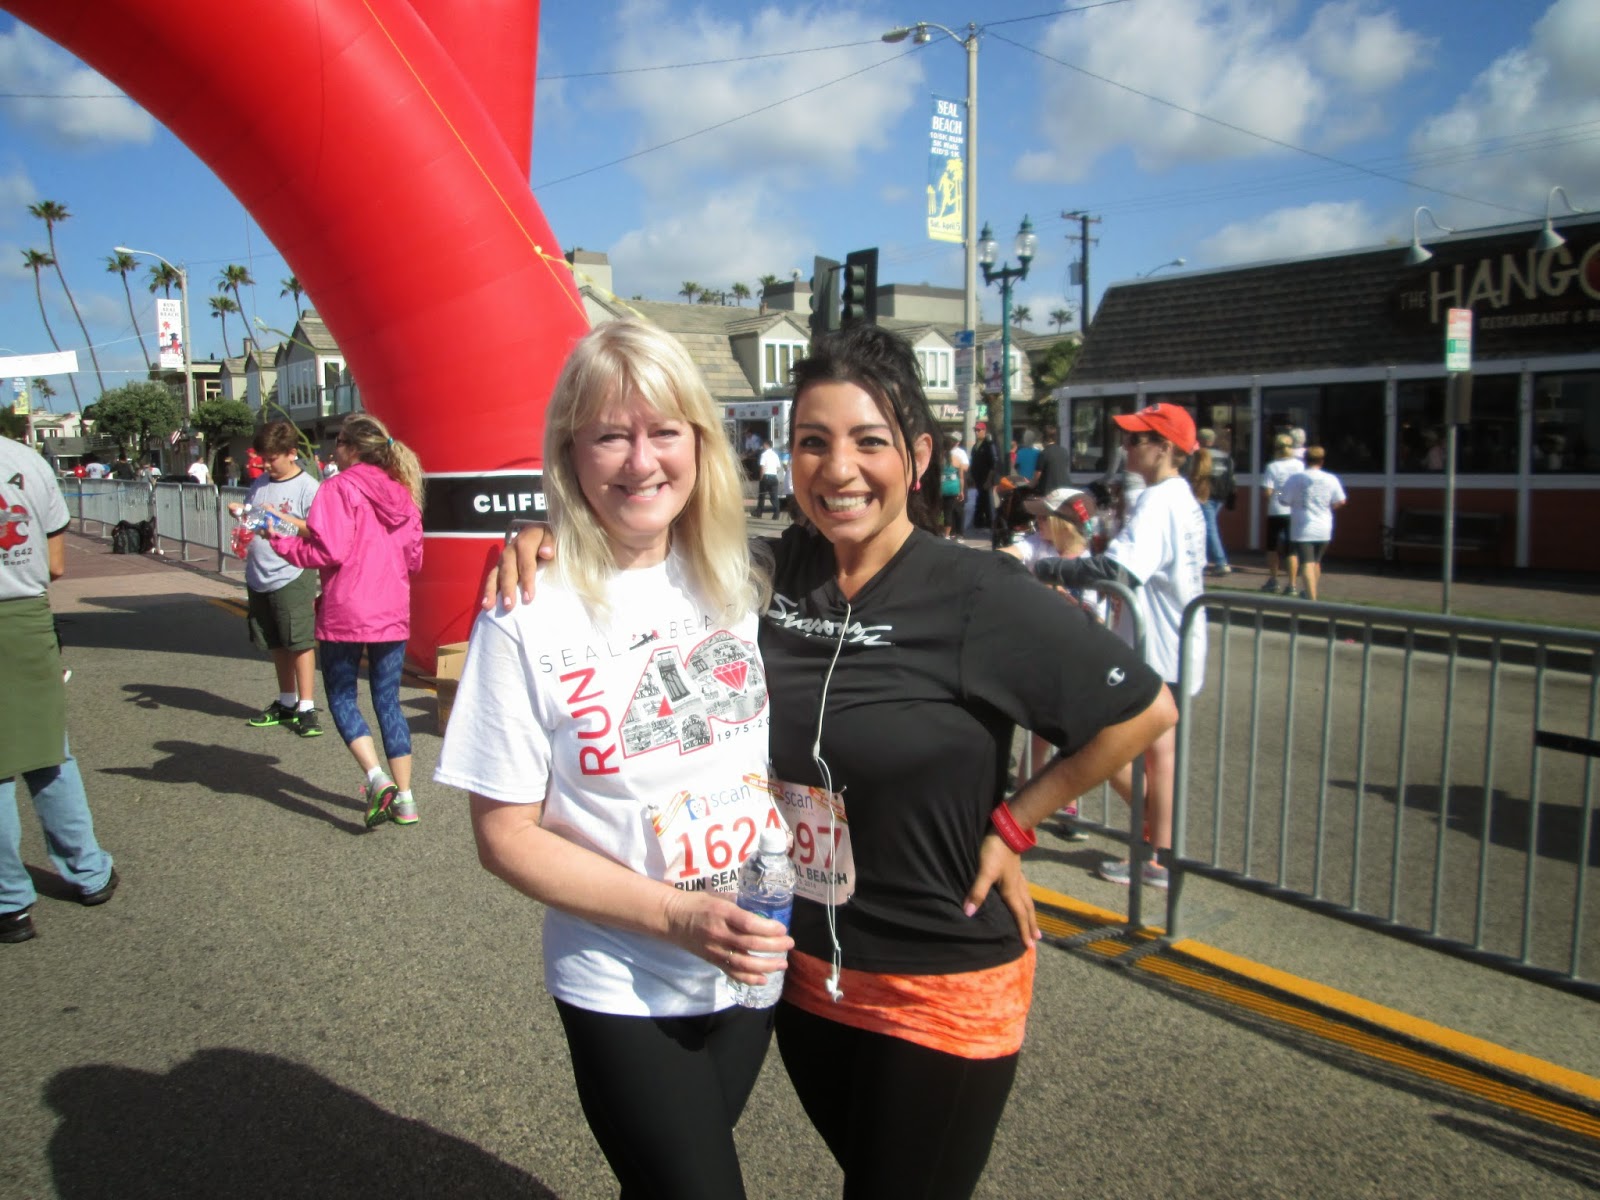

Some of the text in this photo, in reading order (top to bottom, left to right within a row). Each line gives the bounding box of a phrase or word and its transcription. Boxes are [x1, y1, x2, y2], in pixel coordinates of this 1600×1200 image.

[937, 100, 959, 117] SEAL
[932, 116, 962, 134] BEACH
[1401, 291, 1426, 309] THE
[14, 547, 33, 557] 642
[539, 642, 622, 673] SEAL
[559, 667, 621, 777] RUN
[711, 784, 750, 807] scan
[784, 790, 813, 810] scan
[806, 867, 849, 885] BEACH
